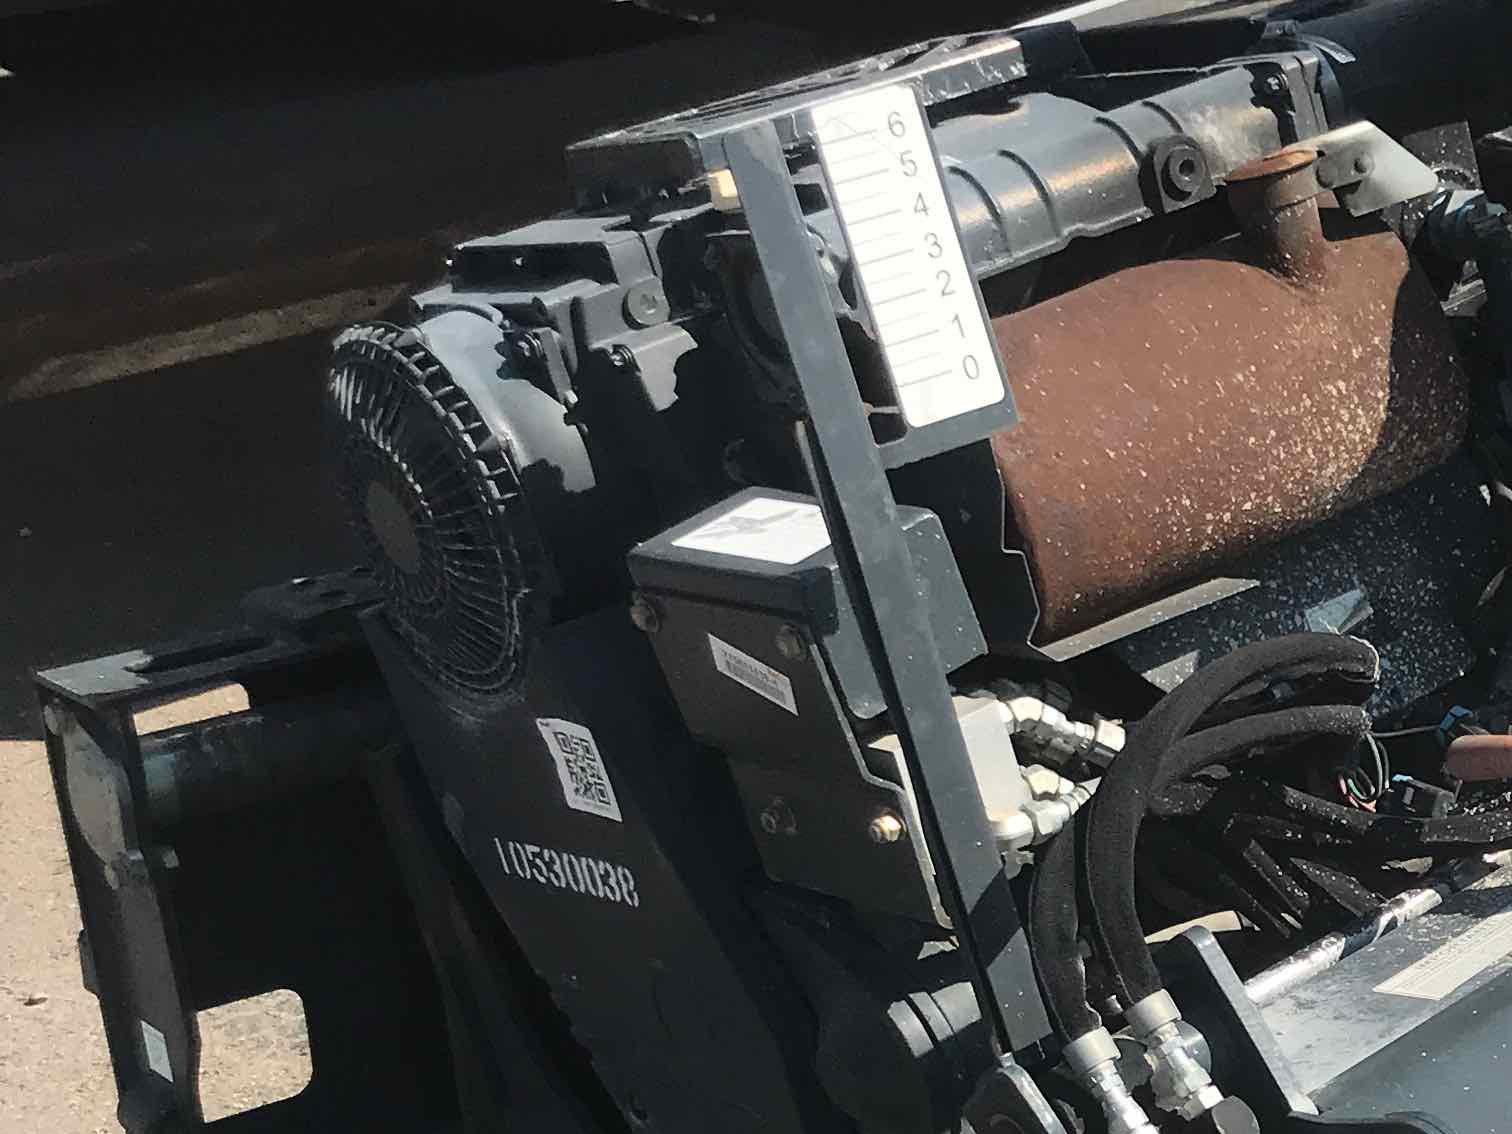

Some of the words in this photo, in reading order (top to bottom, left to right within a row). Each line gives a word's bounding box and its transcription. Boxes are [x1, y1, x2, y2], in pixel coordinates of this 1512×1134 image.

[887, 111, 906, 138] 6
[899, 150, 918, 177] 5
[913, 192, 929, 216] 4
[923, 232, 943, 258] 3
[936, 270, 956, 297] 2
[951, 313, 965, 338] 1
[962, 354, 980, 380] 0
[494, 837, 639, 907] 10530038
